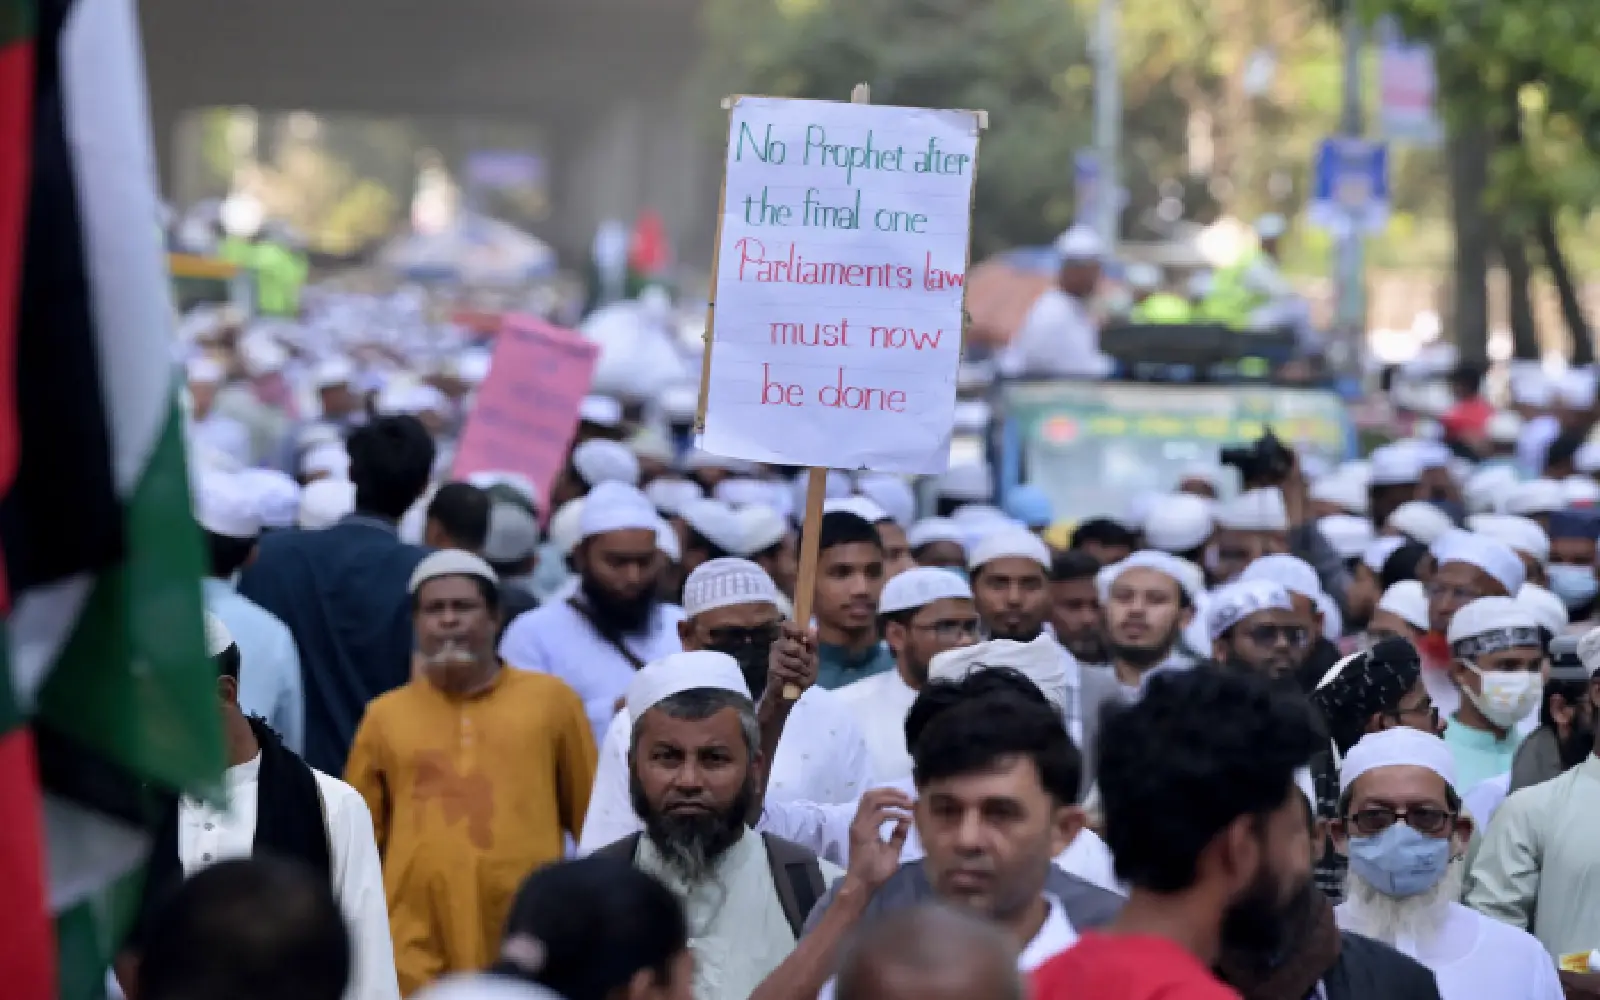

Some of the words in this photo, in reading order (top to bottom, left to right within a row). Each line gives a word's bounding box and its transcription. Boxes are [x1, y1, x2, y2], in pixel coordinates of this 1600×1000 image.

[735, 121, 786, 165] No
[803, 124, 906, 185] Prophet
[914, 137, 970, 175] after
[742, 185, 792, 227] the
[802, 187, 861, 229] final
[874, 208, 928, 233] one
[923, 250, 964, 292] law
[770, 318, 849, 347] must
[869, 325, 943, 350] now
[760, 362, 804, 407] be
[818, 366, 907, 412] done
